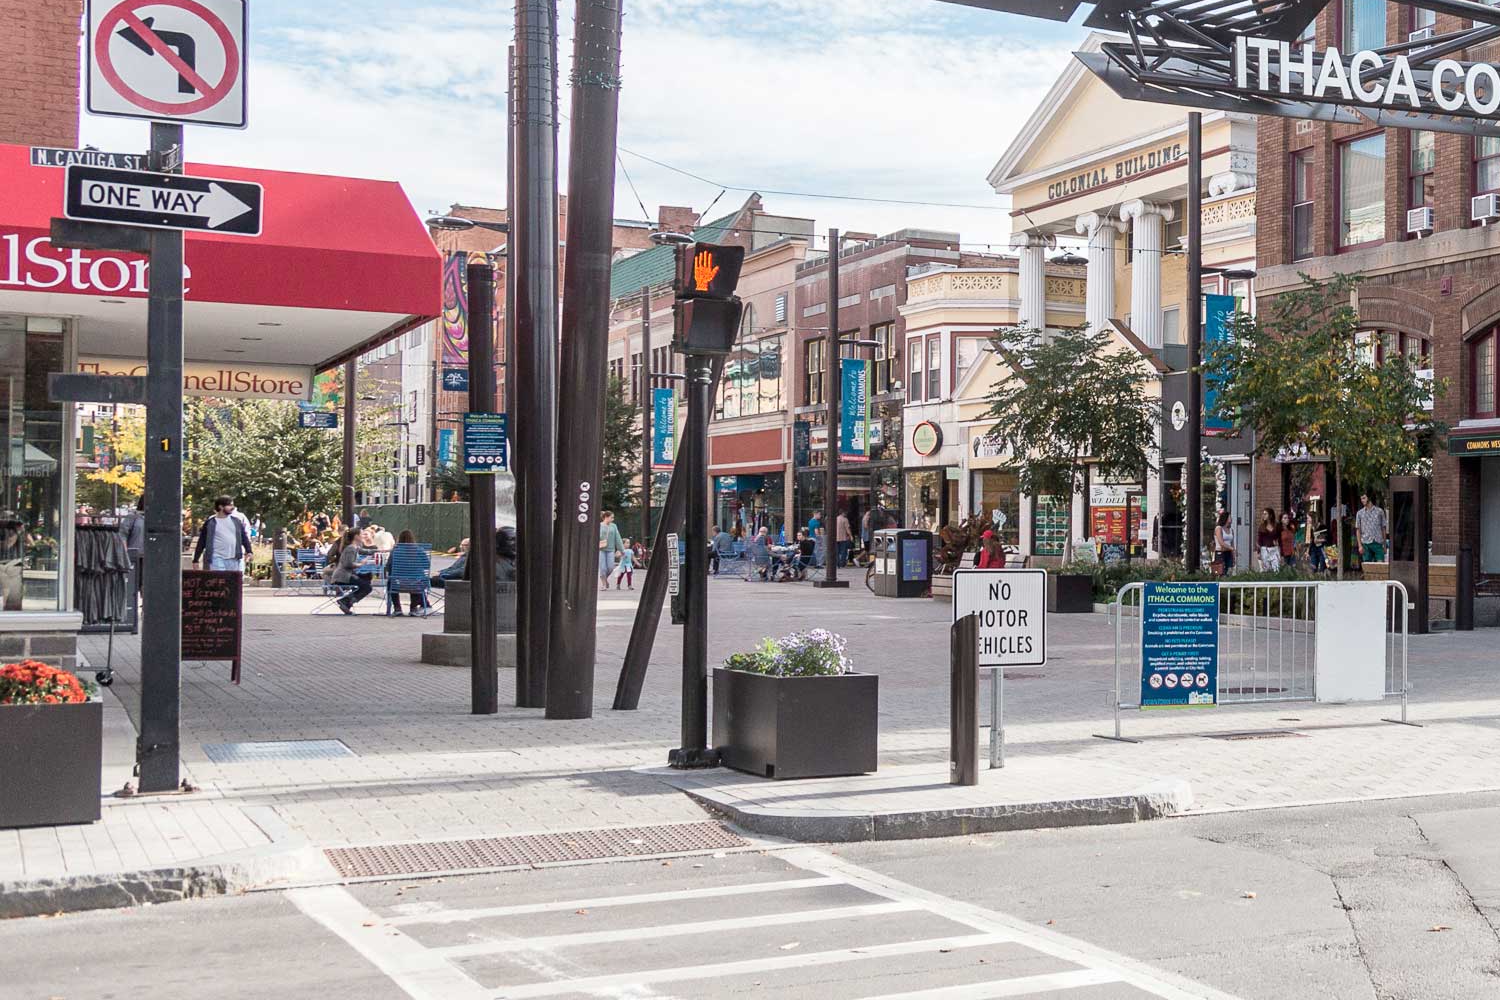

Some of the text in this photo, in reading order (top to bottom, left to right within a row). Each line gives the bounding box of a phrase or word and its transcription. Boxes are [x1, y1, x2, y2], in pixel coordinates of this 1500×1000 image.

[1235, 35, 1421, 108] ITHACA
[56, 151, 116, 168] CAYUGA
[1048, 144, 1181, 199] COLONIAL BUILDING
[89, 184, 203, 213] ONE WAY
[1466, 441, 1490, 450] COMMONS
[989, 583, 1011, 600] NO
